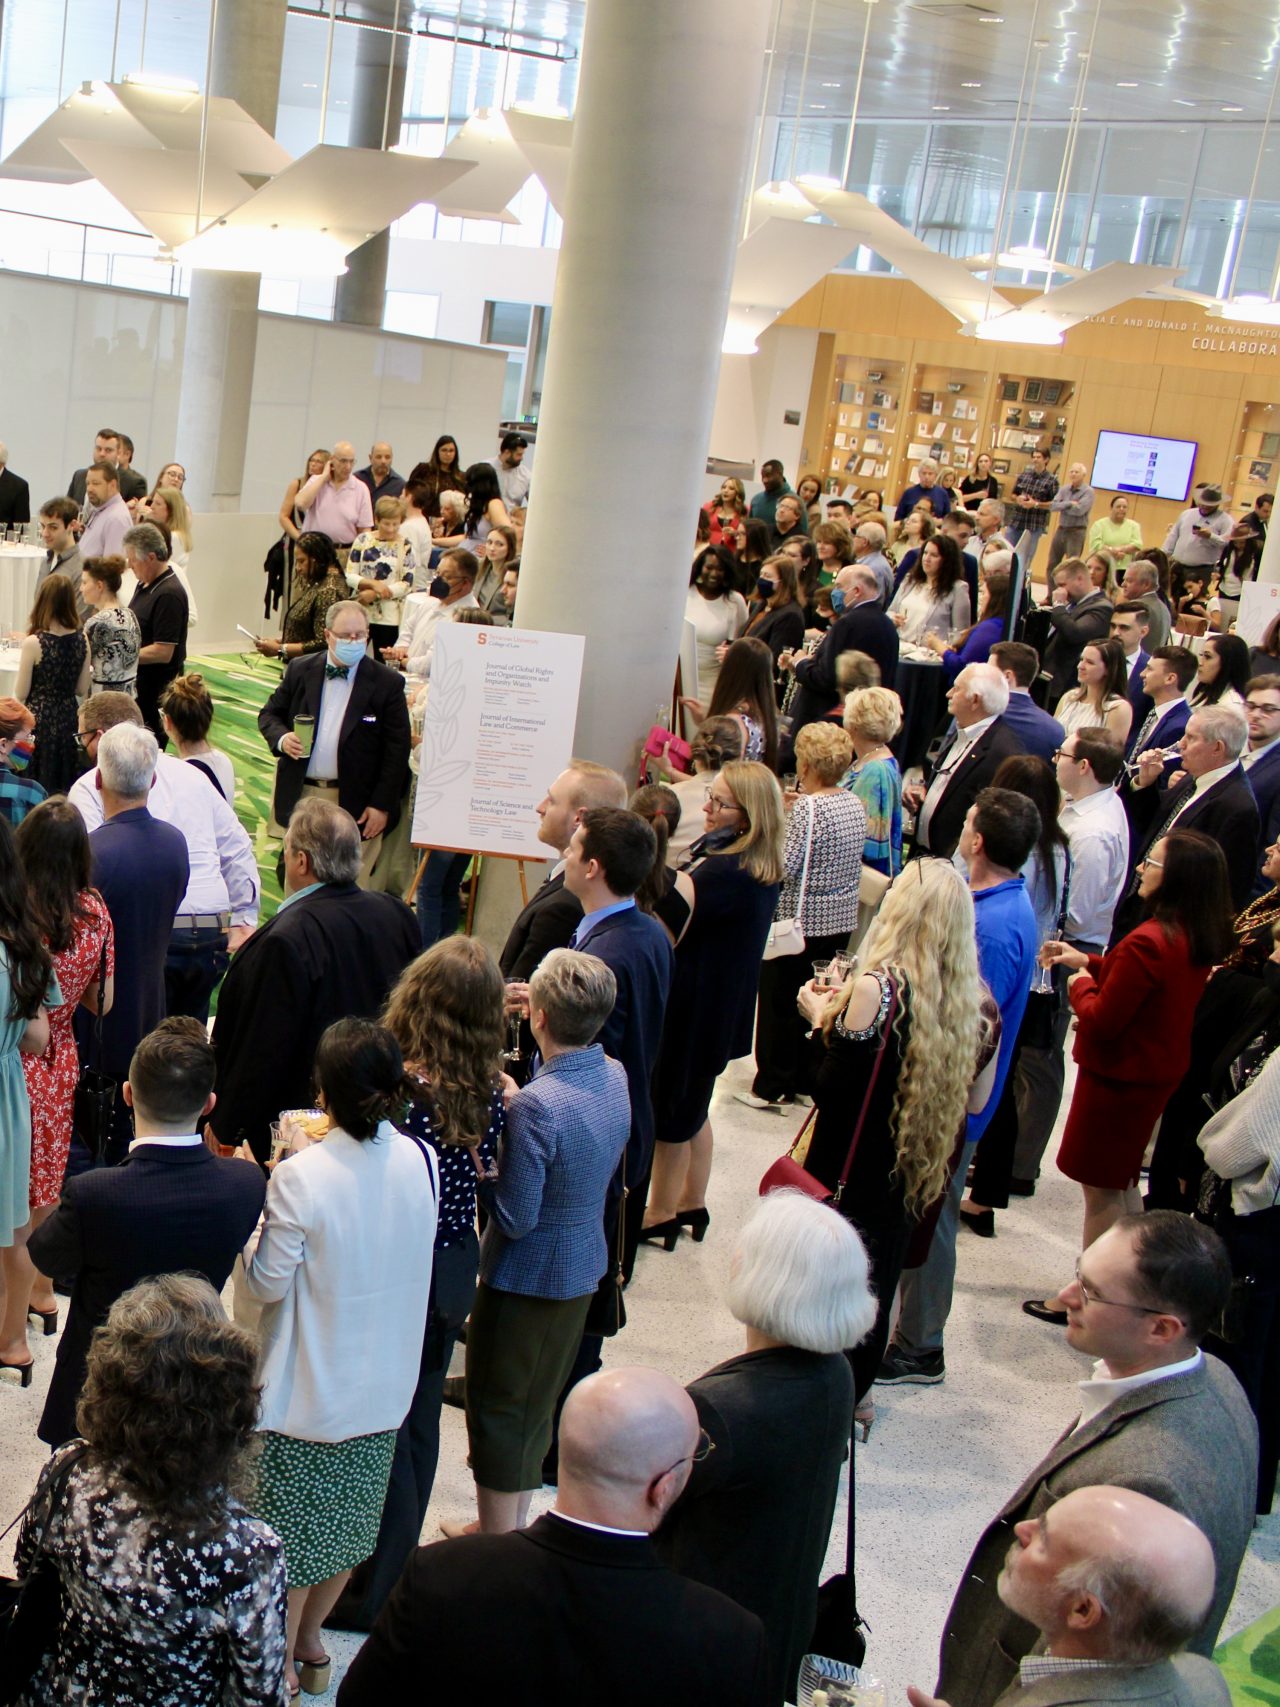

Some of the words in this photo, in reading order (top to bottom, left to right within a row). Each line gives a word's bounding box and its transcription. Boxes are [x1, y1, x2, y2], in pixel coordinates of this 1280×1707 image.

[1205, 323, 1280, 339] MACNAUGHTO
[1191, 337, 1278, 356] COLLABORA
[478, 632, 488, 645] S
[486, 662, 508, 670] Journal
[514, 665, 534, 674] Global
[535, 667, 555, 676] Rights
[497, 671, 538, 682] Organizations
[484, 678, 512, 688] Impunity
[512, 680, 532, 688] Watch
[480, 713, 502, 722] Journal
[509, 716, 546, 726] International
[505, 723, 538, 732] Commerce
[470, 798, 492, 806] Journal
[470, 805, 504, 816] Technology
